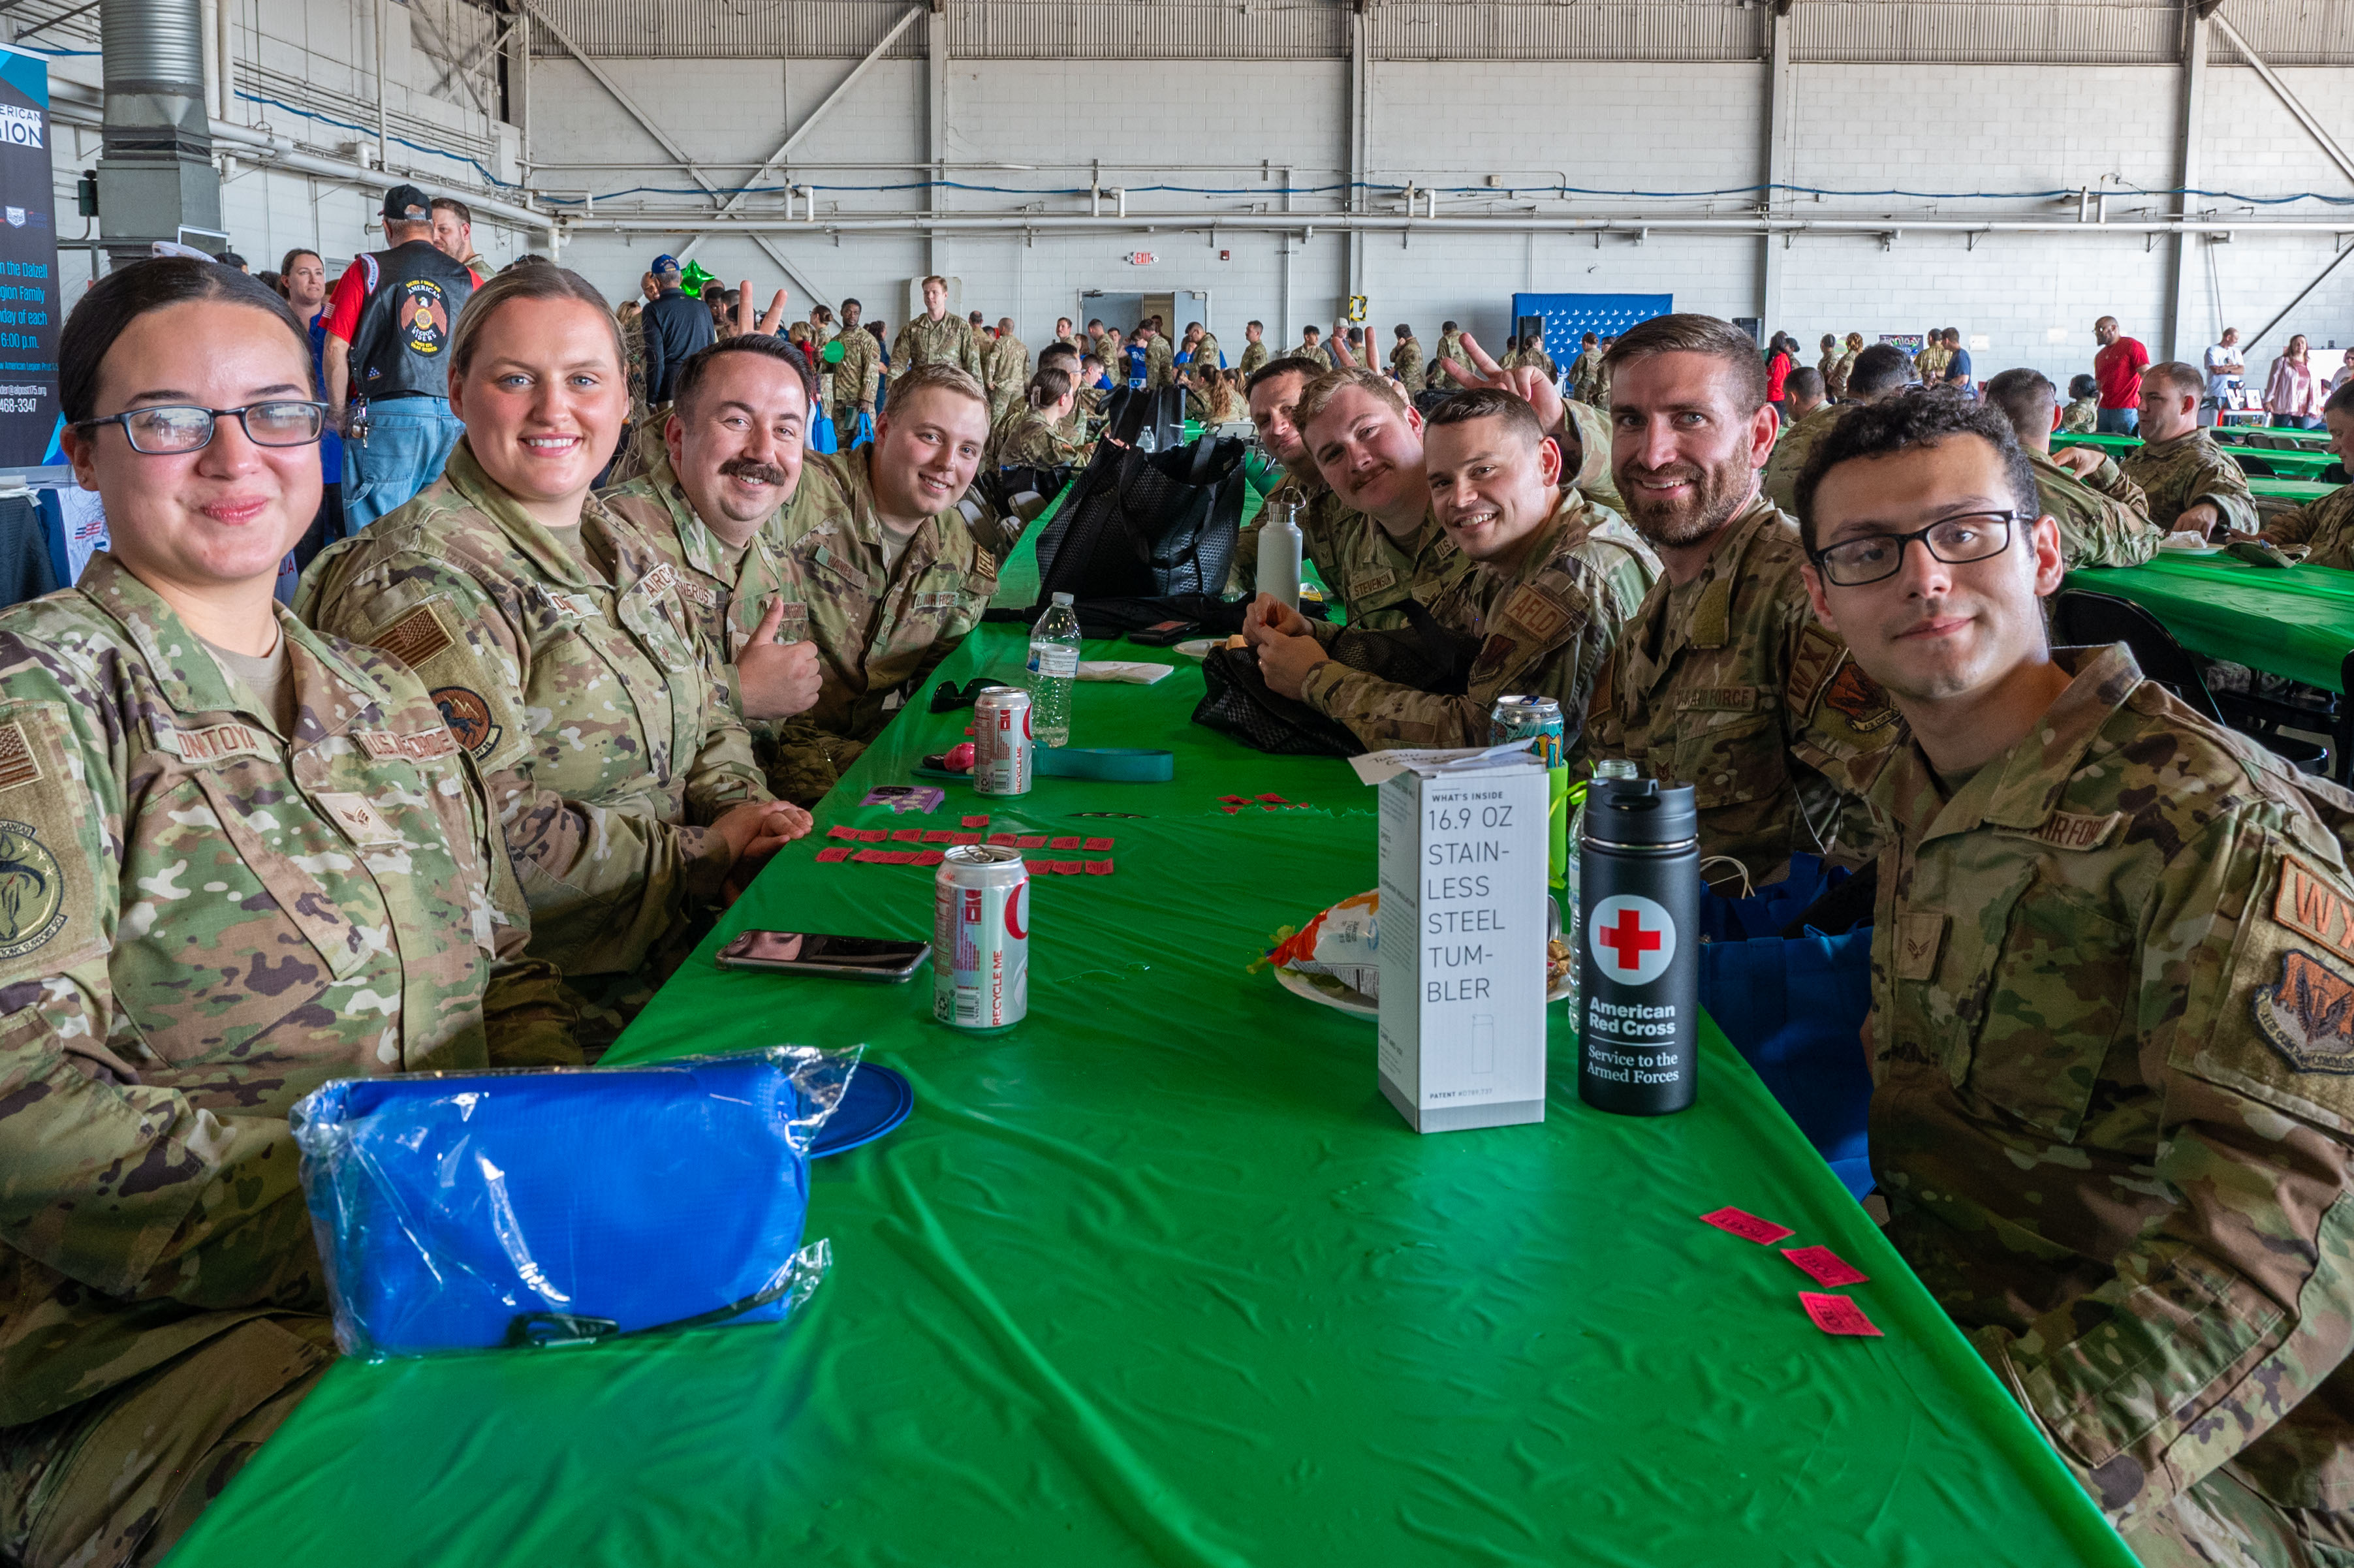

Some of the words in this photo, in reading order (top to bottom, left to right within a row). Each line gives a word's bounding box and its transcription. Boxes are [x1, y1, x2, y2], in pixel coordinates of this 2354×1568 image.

[0, 120, 43, 147] ION
[7, 261, 20, 276] the
[22, 262, 48, 279] Dalzell
[1137, 253, 1150, 264] EXIT
[19, 286, 45, 304] Family
[407, 285, 441, 299] AMERICAN
[18, 309, 26, 324] of
[27, 311, 48, 325] each
[1, 332, 20, 348] 6:00
[22, 335, 39, 350] p.m.
[1355, 572, 1392, 597] STEVENSON
[1510, 593, 1558, 633] AFLD
[1789, 640, 1828, 700] WX
[1710, 689, 1751, 706] FORCE
[1016, 746, 1022, 760] ME
[1432, 793, 1468, 802] WHAT'S
[1471, 791, 1503, 800] INSIDE
[1428, 808, 1471, 830] 16.9
[1482, 806, 1513, 828] OZ
[1428, 840, 1510, 865] STAIN-
[1428, 875, 1490, 900] LESS
[1428, 909, 1505, 934] STEEL
[993, 950, 1003, 969] ME
[1428, 944, 1494, 968] TUM-
[992, 971, 1002, 1026] RECYCLE
[1428, 978, 1490, 1002] BLER
[1590, 996, 1676, 1019] American
[1589, 1012, 1619, 1033] Red
[1622, 1020, 1676, 1036] Cross
[1588, 1044, 1635, 1066] Service
[1638, 1055, 1654, 1067] to
[1656, 1052, 1678, 1067] the
[1587, 1061, 1630, 1083] Armed
[1633, 1070, 1679, 1084] Forces
